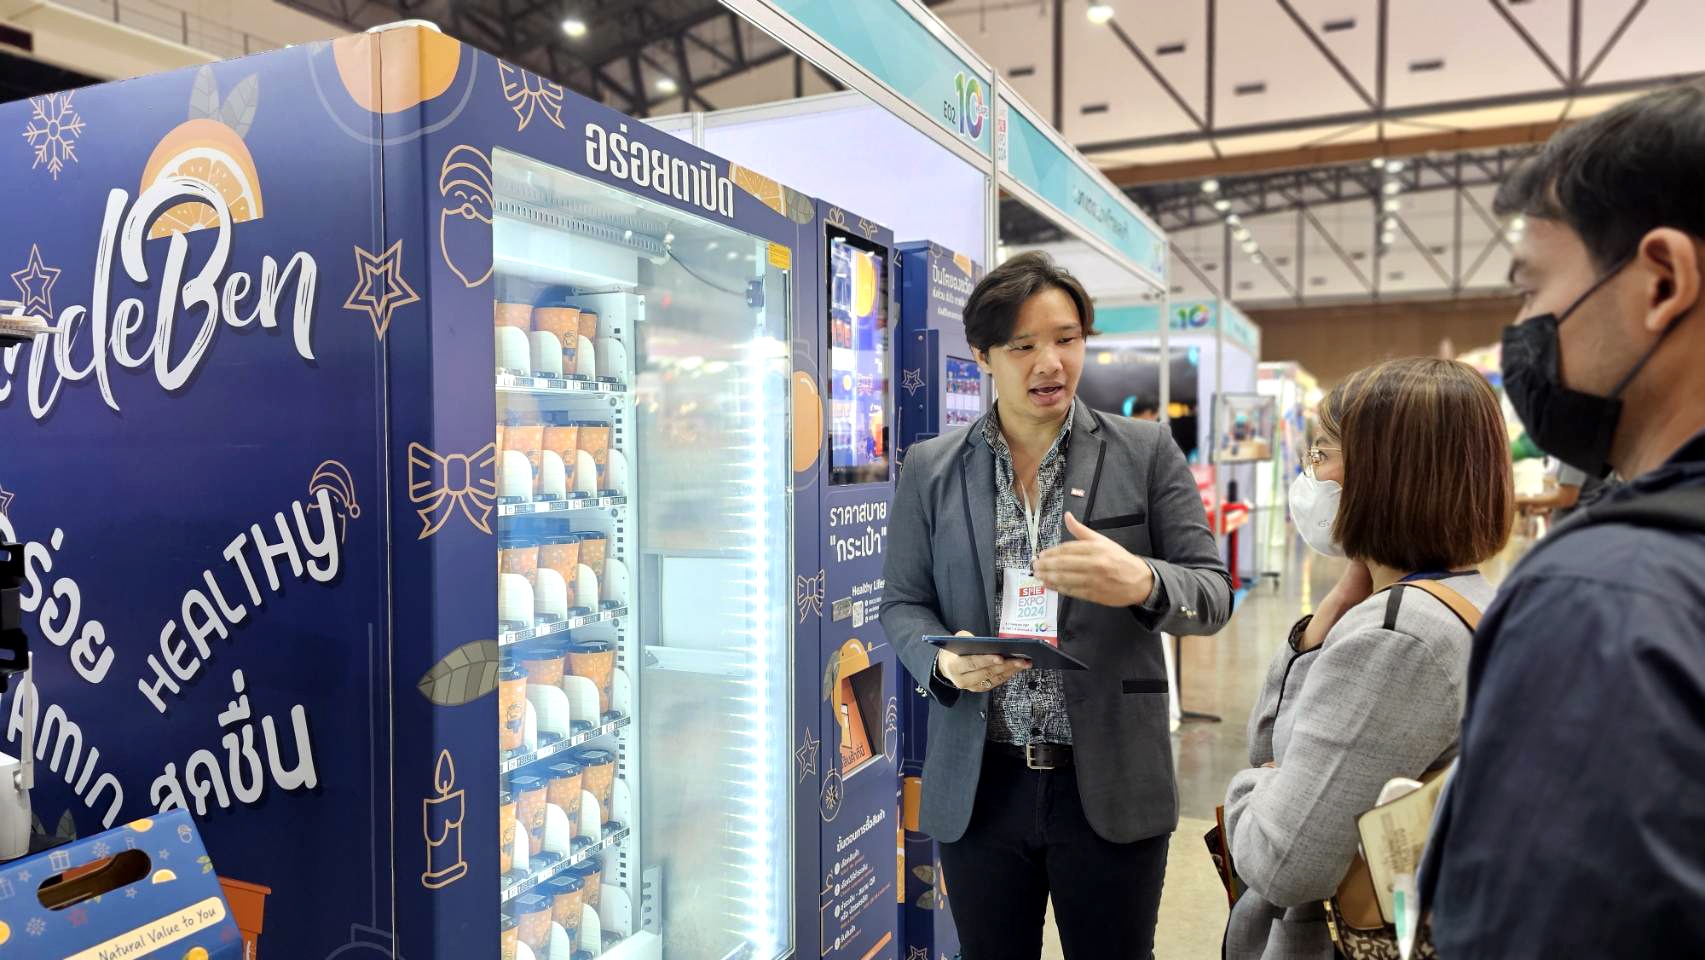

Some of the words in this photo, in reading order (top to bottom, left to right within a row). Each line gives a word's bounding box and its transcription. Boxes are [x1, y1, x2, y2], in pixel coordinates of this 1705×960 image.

[585, 122, 734, 218] อร่อยตาปิด
[830, 501, 887, 527] ราคาสบาย
[0, 511, 115, 684] ร่อย
[852, 582, 872, 597] Healthy
[1018, 596, 1045, 607] EXPO
[1017, 606, 1044, 618] 2024
[150, 669, 317, 816] สดชื่น
[98, 935, 146, 960] Natural
[147, 922, 180, 943] Value
[182, 915, 194, 928] to
[198, 907, 217, 924] You
